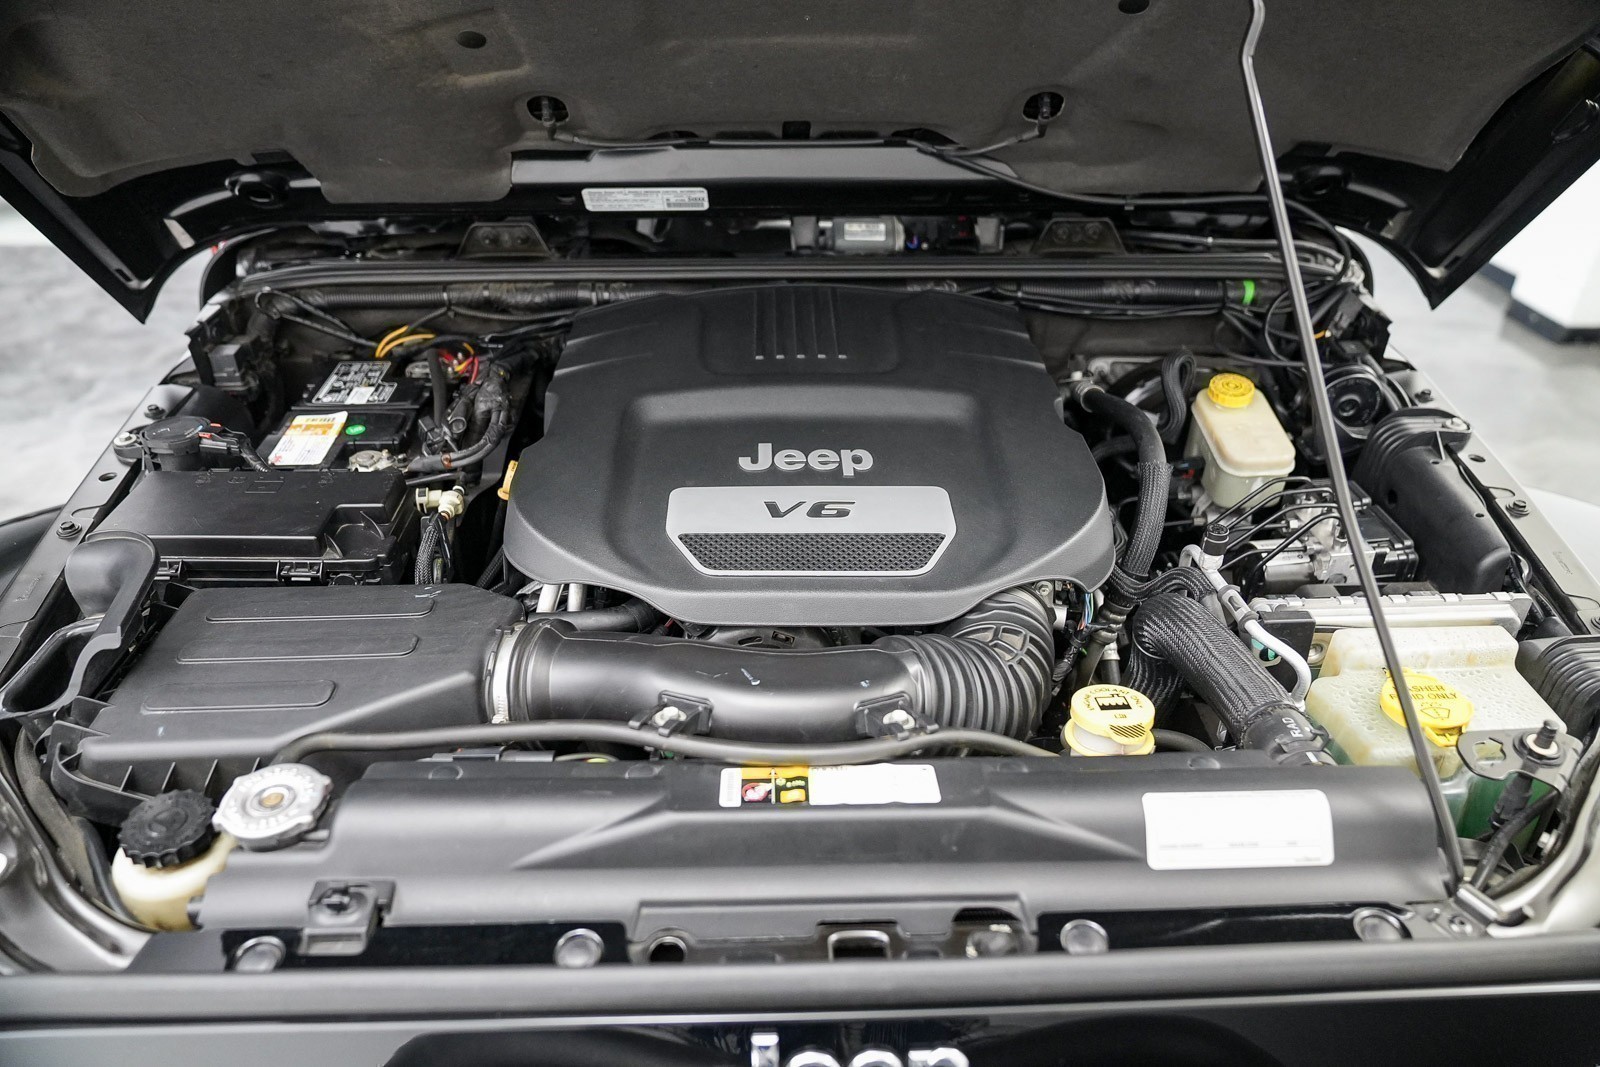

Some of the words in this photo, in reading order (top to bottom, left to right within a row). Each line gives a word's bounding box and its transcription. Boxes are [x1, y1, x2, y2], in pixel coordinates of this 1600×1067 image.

[738, 442, 874, 478] Jeep
[763, 501, 856, 518] V6
[1427, 692, 1458, 700] ONLY
[1281, 717, 1304, 738] RAD
